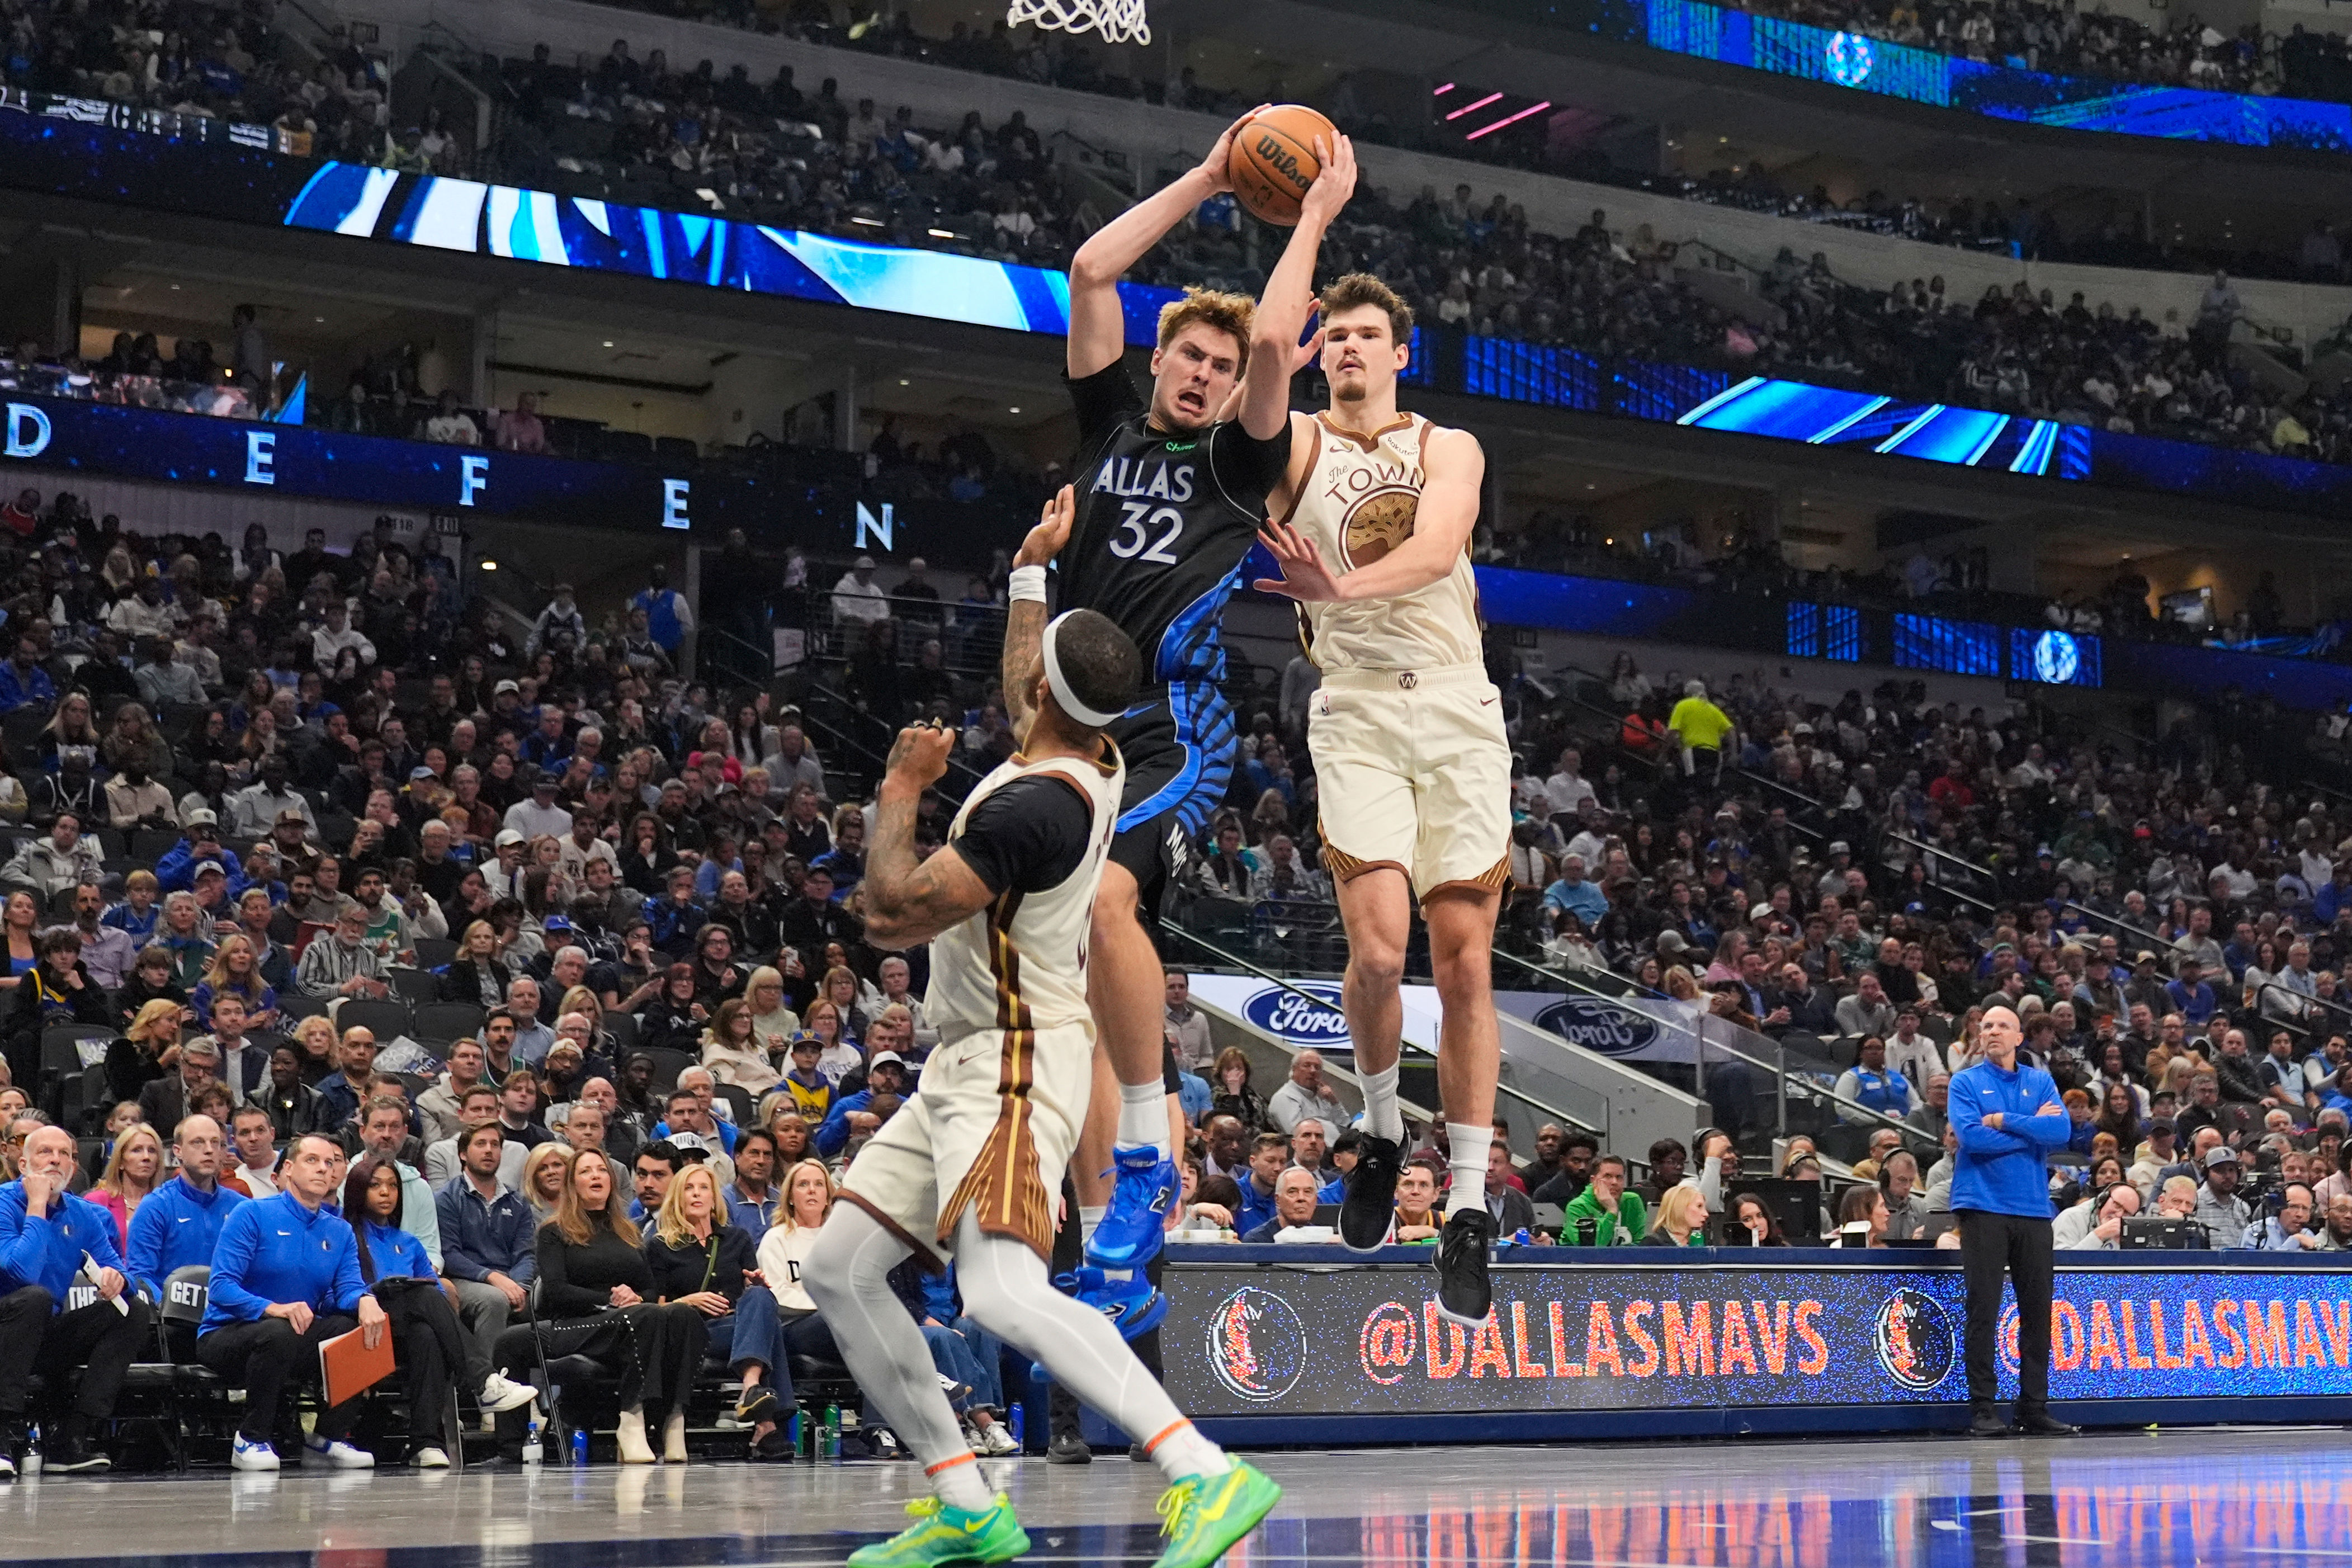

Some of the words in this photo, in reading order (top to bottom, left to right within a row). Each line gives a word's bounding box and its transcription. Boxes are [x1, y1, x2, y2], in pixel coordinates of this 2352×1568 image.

[1256, 135, 1312, 191] Wilso
[1387, 436, 1418, 456] Rakuten
[1090, 455, 1195, 502] ALLAS
[1329, 465, 1349, 484] The
[1109, 502, 1183, 565] 32
[171, 1281, 202, 1307] GET
[1360, 1300, 1827, 1385] @DALLASMAVS
